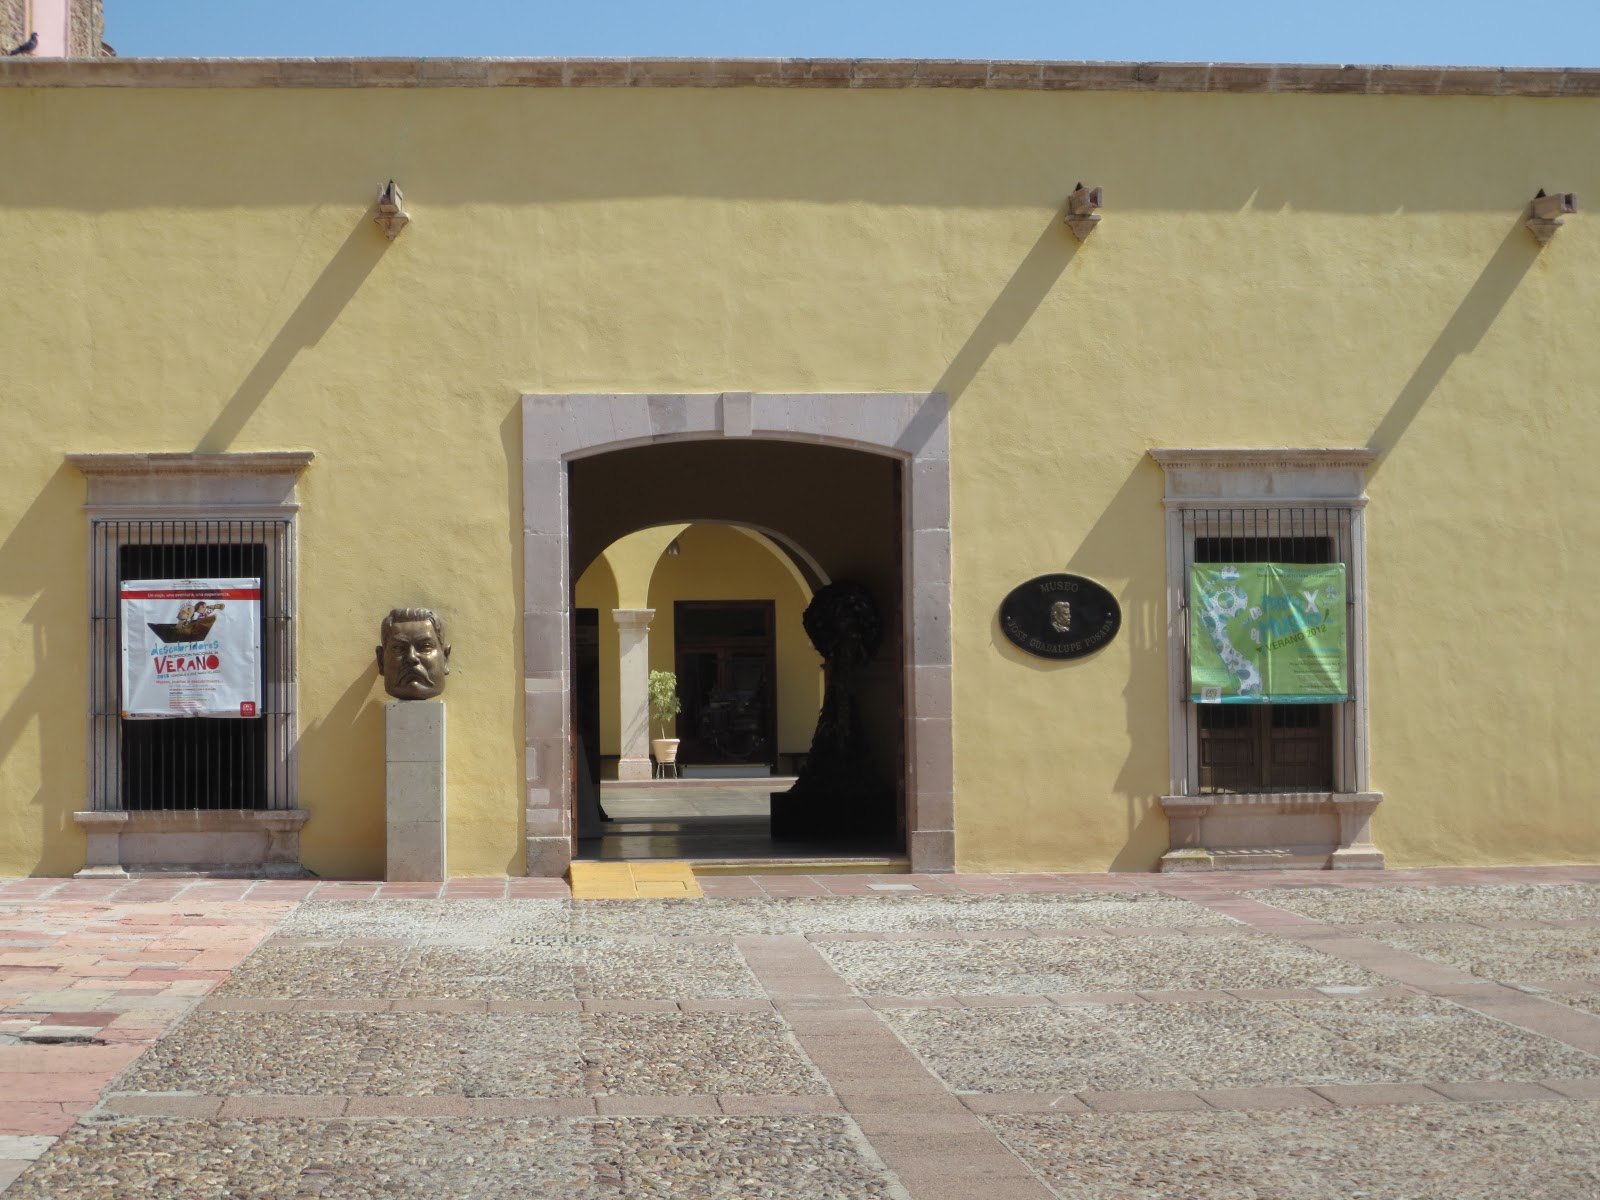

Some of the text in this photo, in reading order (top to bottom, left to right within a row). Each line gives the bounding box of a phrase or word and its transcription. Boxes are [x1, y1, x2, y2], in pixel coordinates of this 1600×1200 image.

[1040, 581, 1079, 593] MUSEO
[1303, 589, 1319, 613] X
[1007, 620, 1113, 653] JOSE GUADALUPE POSADA
[1265, 624, 1327, 652] VERANO 2012
[153, 654, 220, 674] VERANO
